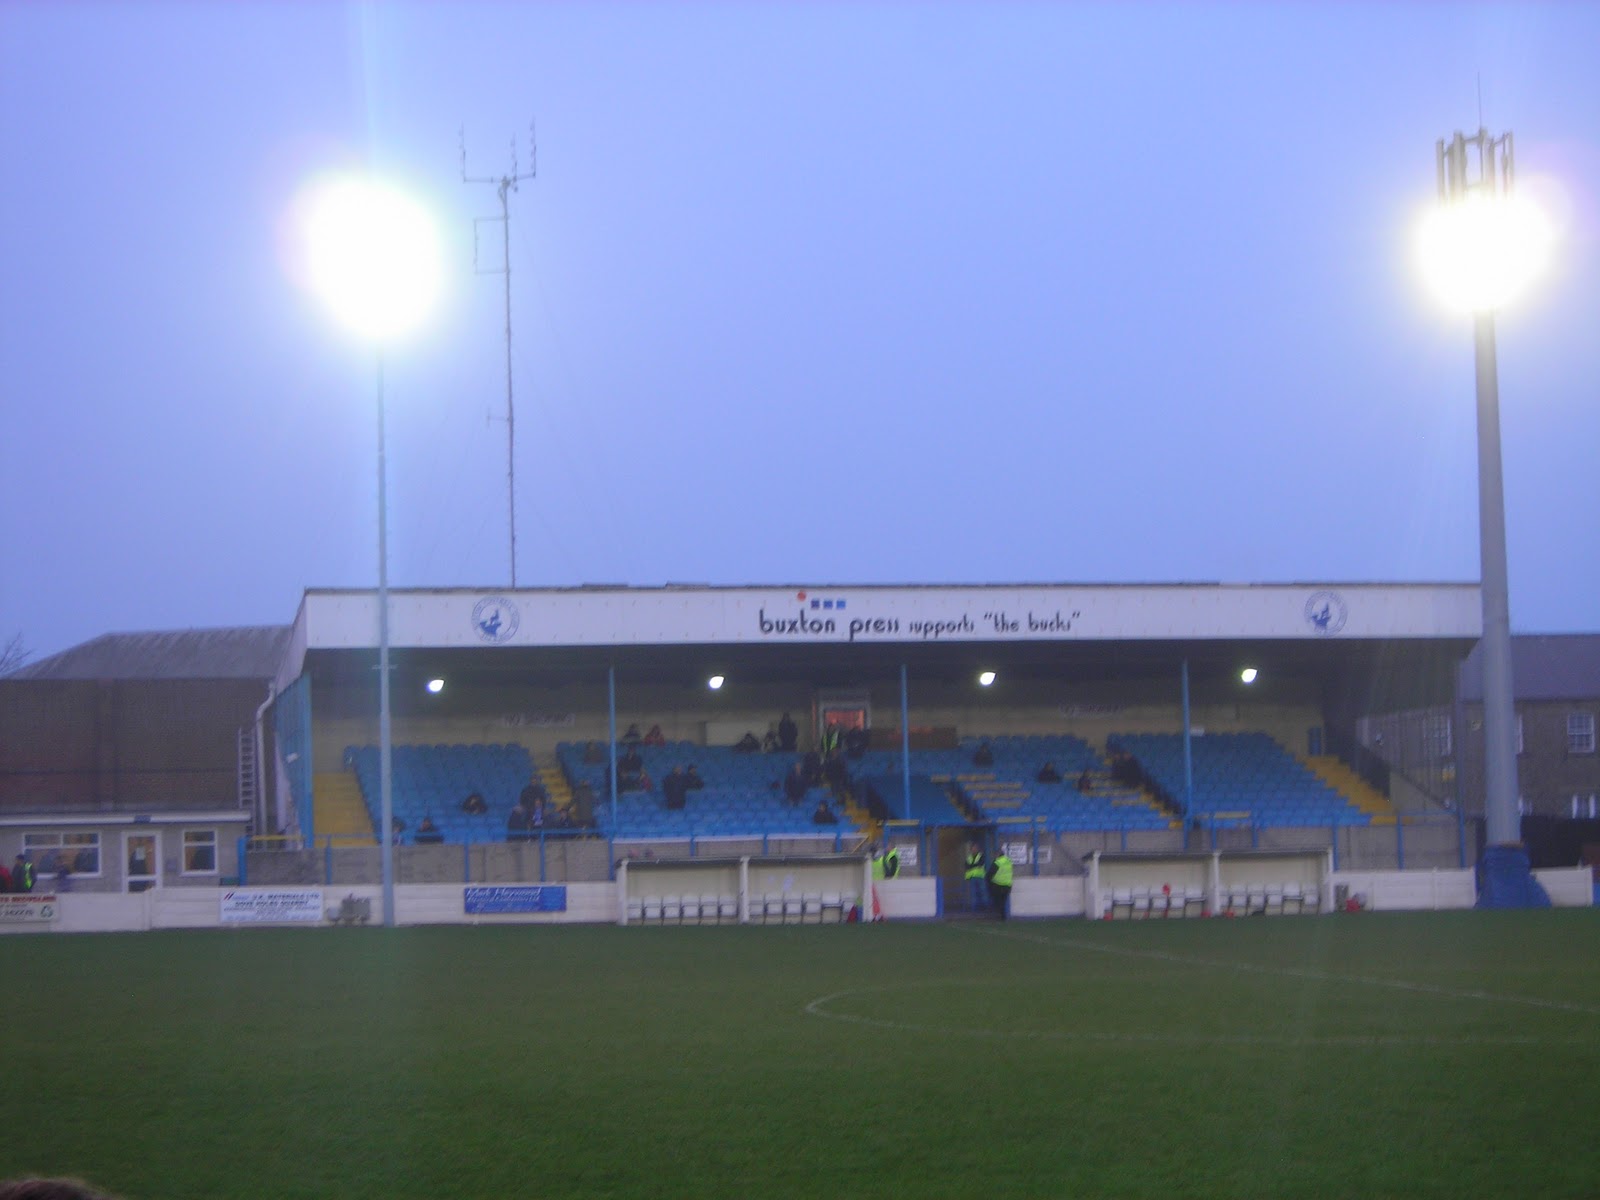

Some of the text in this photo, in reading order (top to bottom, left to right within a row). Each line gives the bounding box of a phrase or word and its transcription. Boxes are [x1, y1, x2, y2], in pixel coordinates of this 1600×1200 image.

[759, 608, 835, 634] buxton
[849, 617, 900, 641] press
[909, 613, 974, 639] supports
